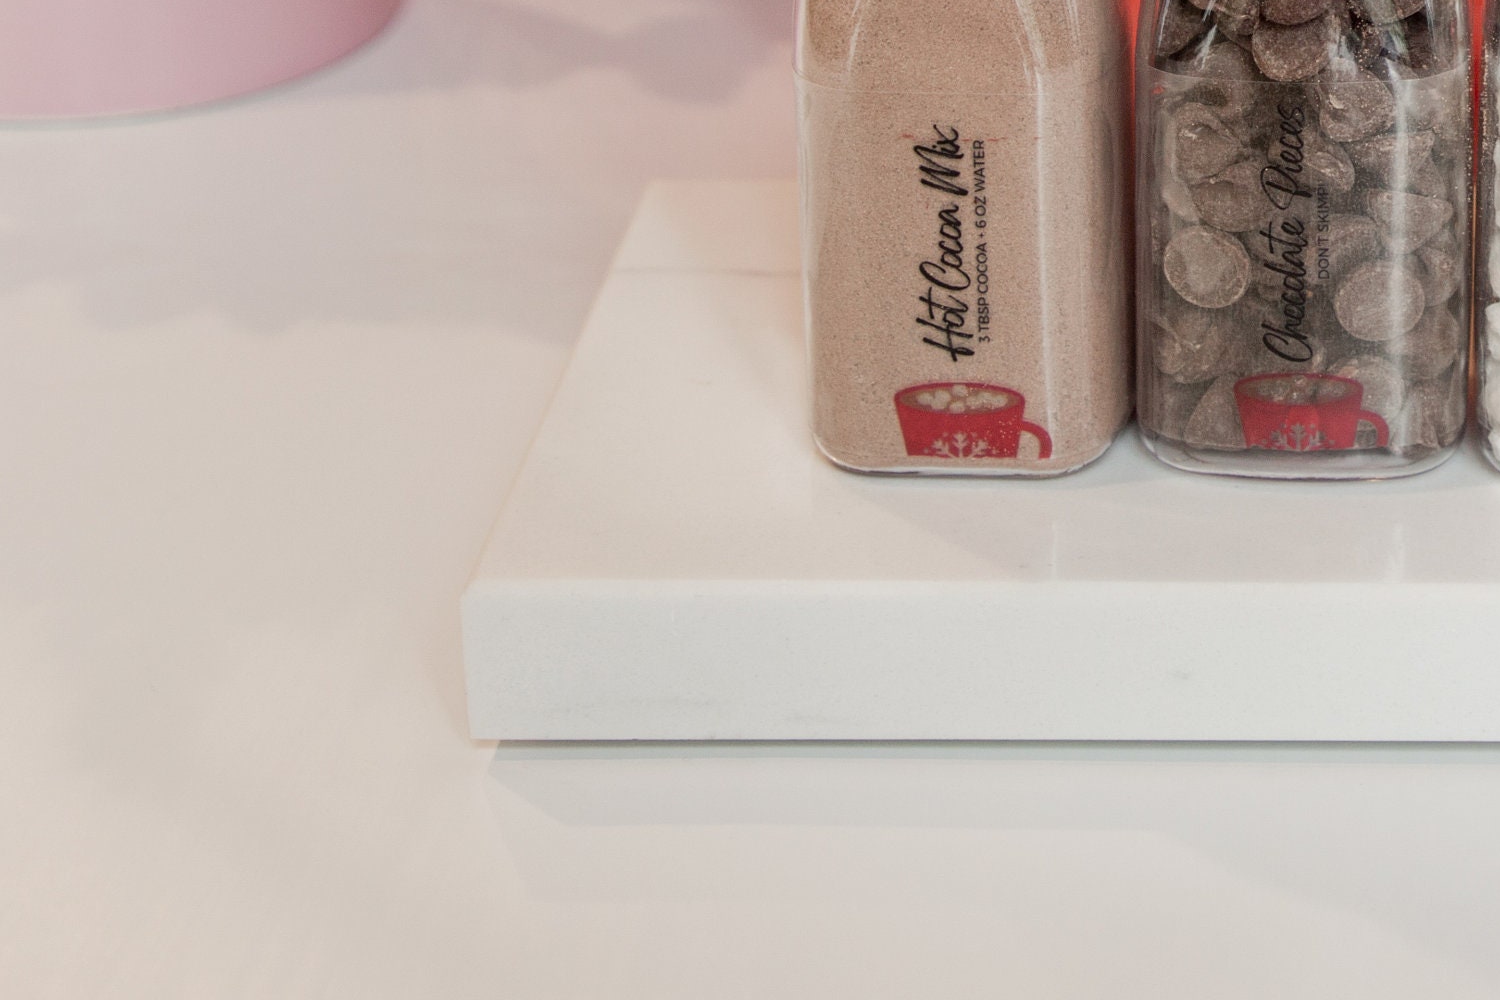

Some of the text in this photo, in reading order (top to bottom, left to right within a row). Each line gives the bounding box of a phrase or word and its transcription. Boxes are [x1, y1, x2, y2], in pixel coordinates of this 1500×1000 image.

[972, 140, 986, 193] WATER
[974, 196, 987, 217] OZ
[975, 220, 987, 229] 6
[913, 124, 975, 363] Hot Cocoa Mix
[1260, 105, 1313, 363] Chocolate Pieces
[976, 242, 989, 294] COCOA
[1317, 235, 1330, 280] DON'T
[978, 297, 990, 333] TBSP
[978, 335, 991, 344] 3
